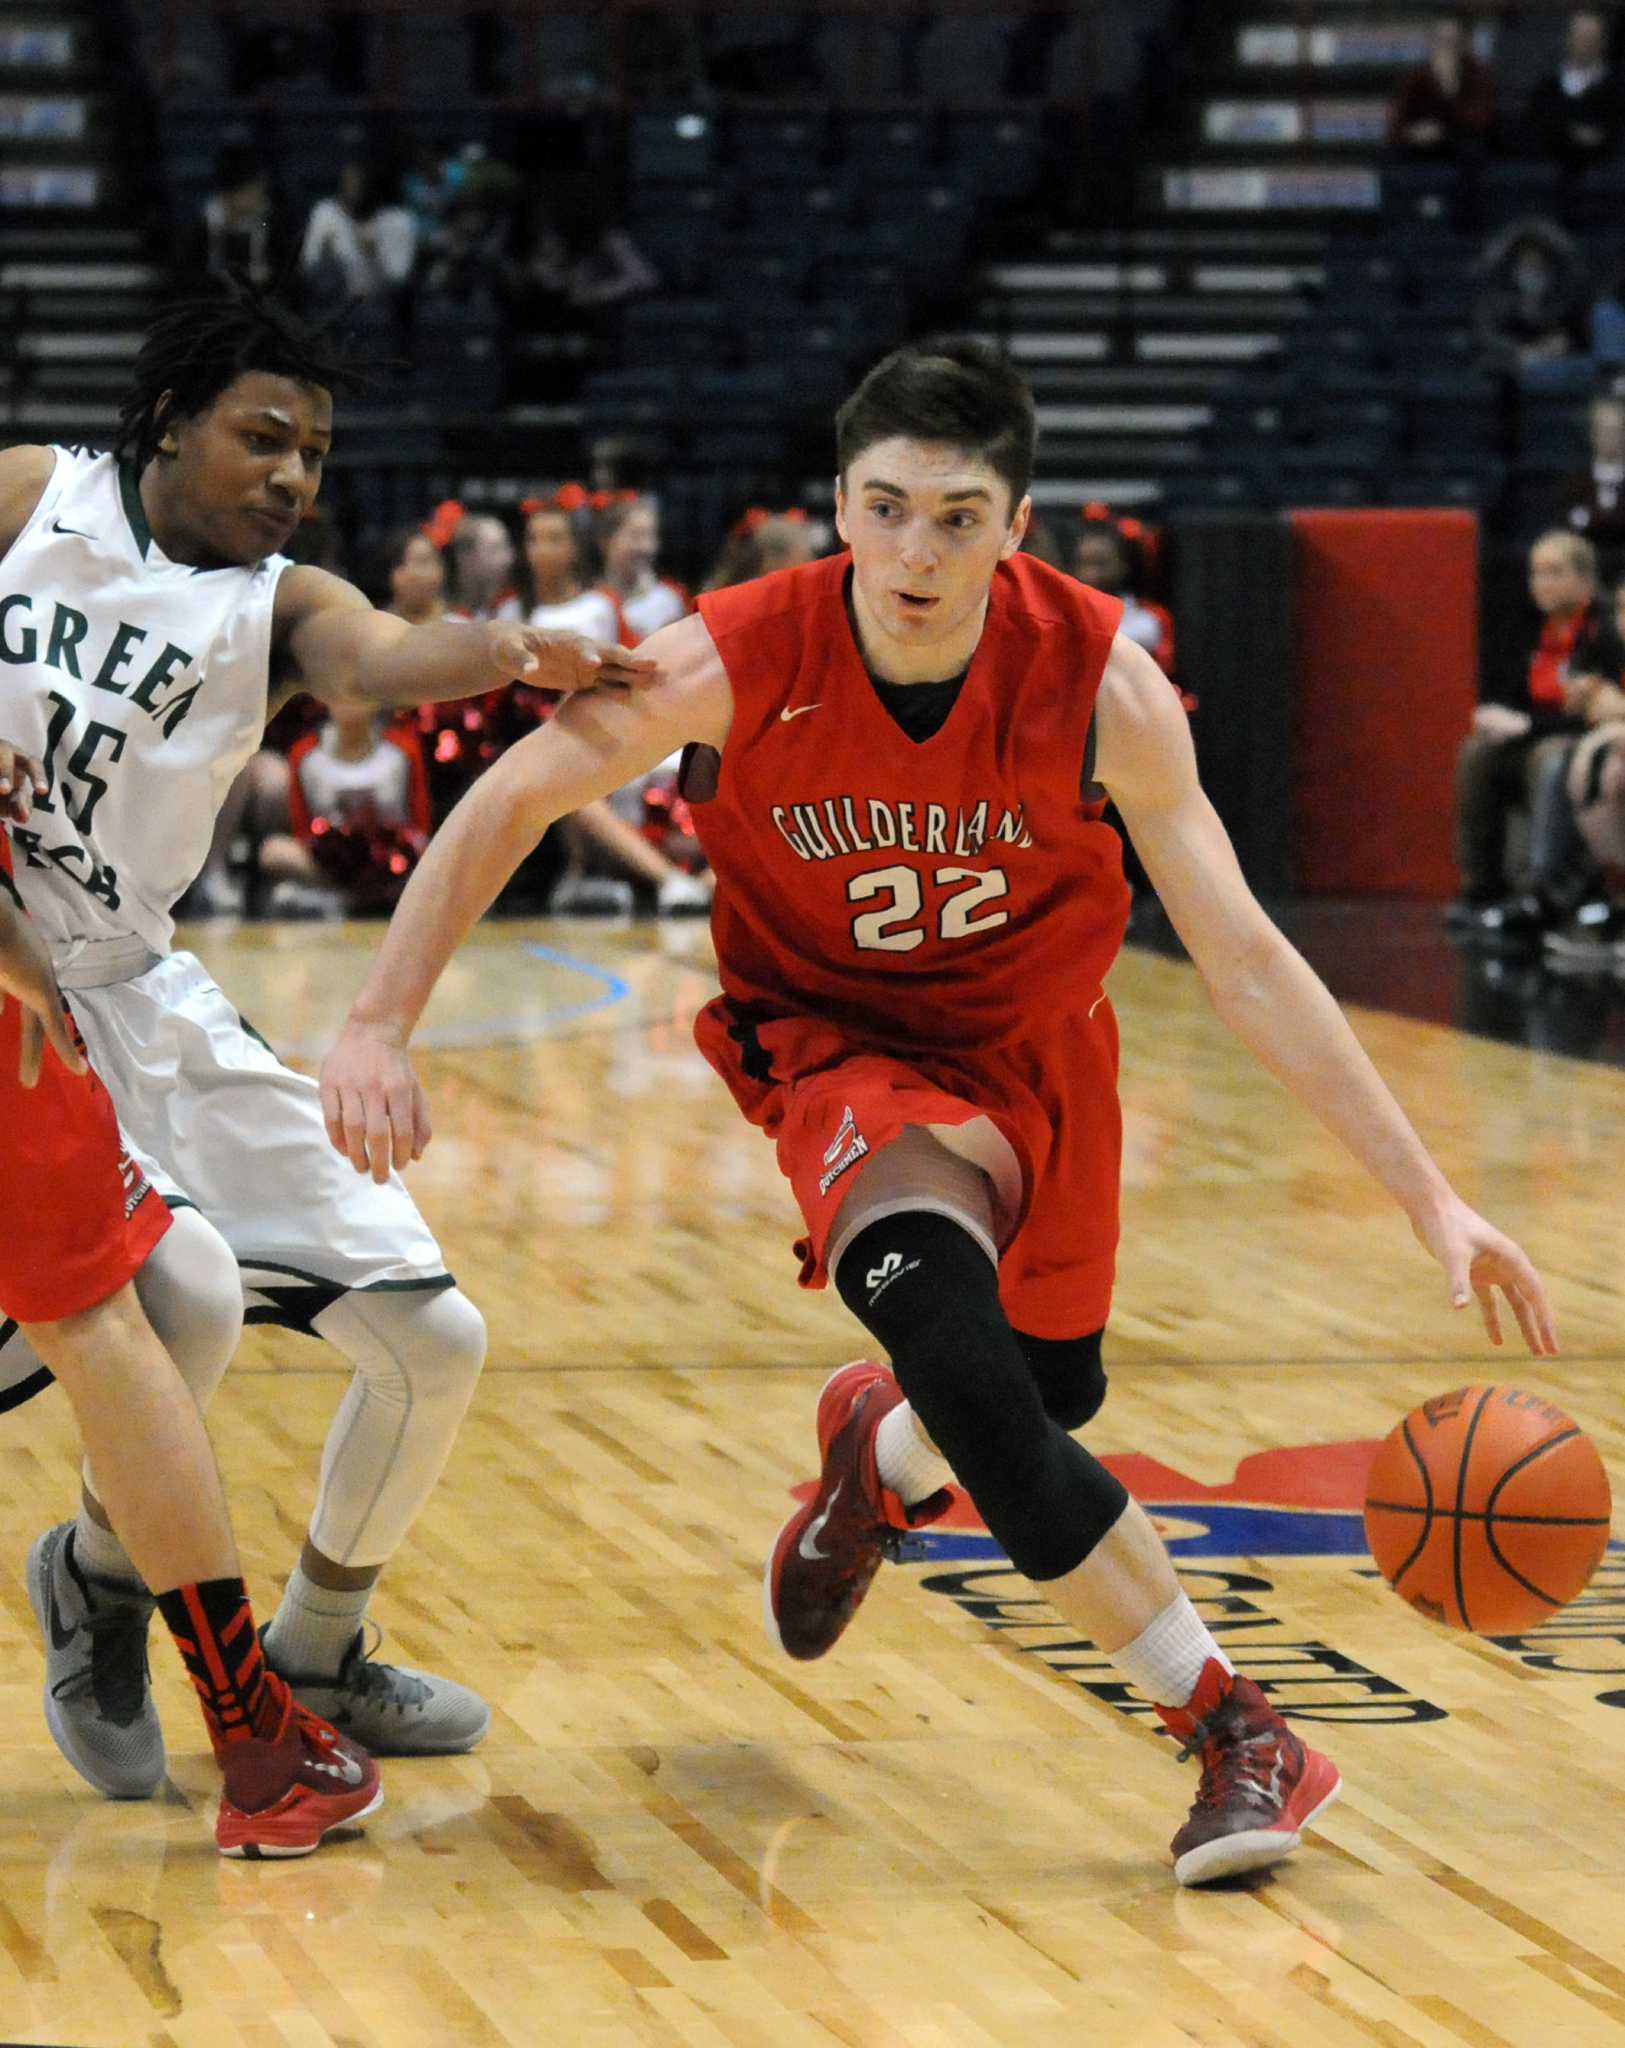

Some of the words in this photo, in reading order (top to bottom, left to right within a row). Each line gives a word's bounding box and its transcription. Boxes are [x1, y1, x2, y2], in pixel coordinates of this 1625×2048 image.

[32, 690, 128, 836] 15
[847, 863, 1009, 952] 22
[818, 1134, 870, 1198] DUTCHMEN
